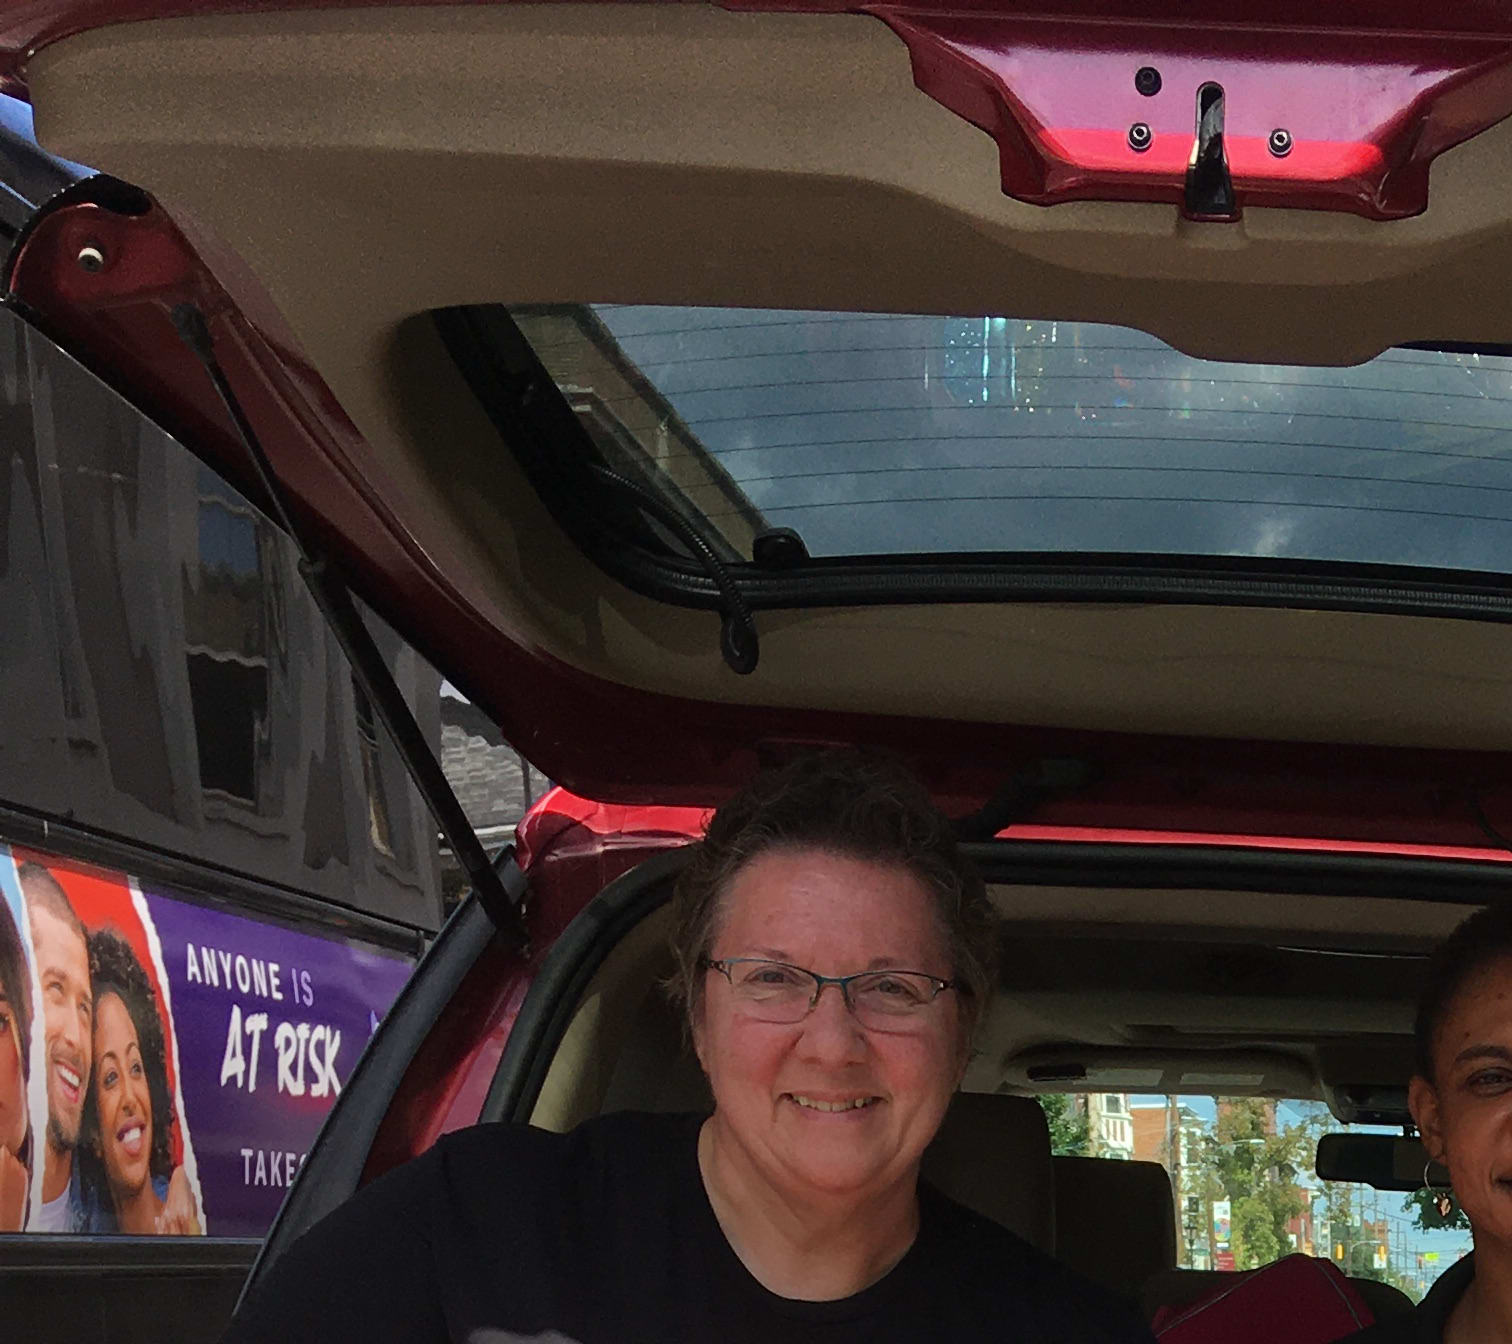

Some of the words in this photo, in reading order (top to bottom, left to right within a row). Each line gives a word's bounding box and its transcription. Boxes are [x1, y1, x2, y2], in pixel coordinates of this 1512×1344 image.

[186, 942, 283, 1000] ANYONE
[292, 968, 314, 1007] IS
[220, 1004, 268, 1093] AT
[274, 1021, 343, 1098] RISK
